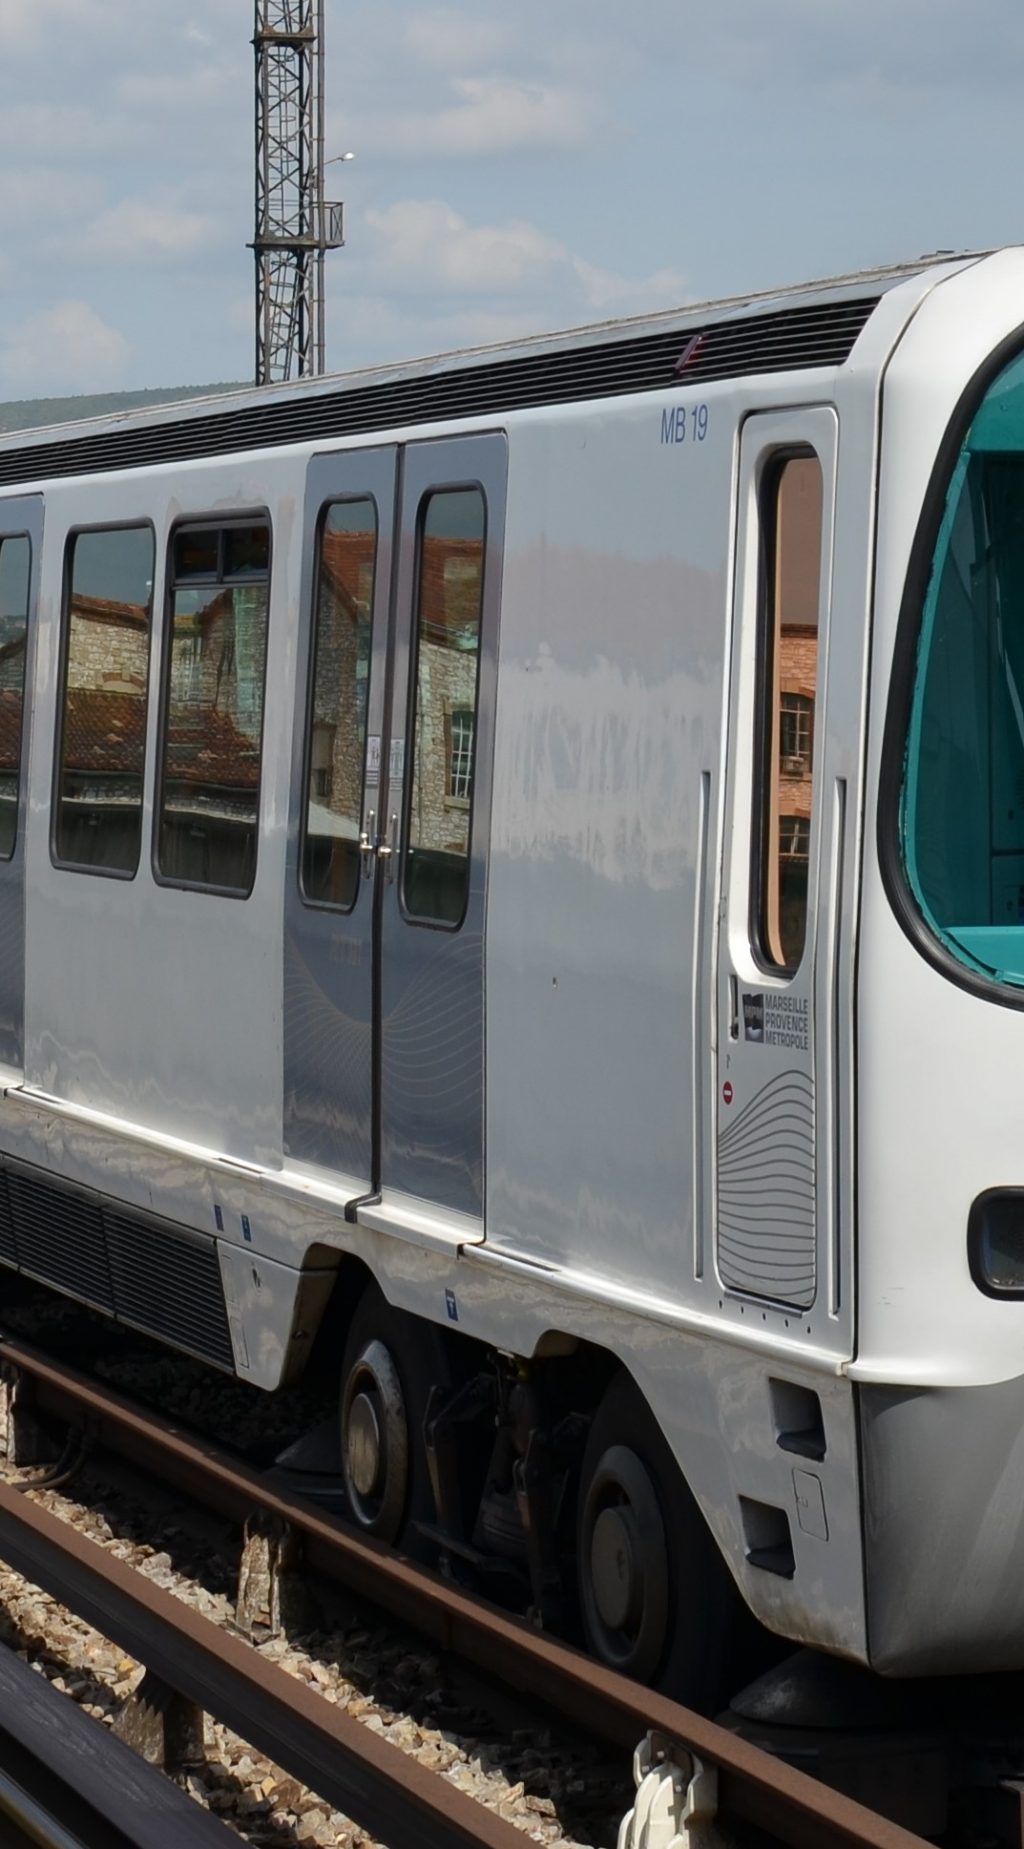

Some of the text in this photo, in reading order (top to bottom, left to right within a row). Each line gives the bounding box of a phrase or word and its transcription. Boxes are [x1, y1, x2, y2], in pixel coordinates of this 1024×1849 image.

[661, 404, 708, 444] MB 19
[765, 994, 808, 1015] MARSEILLE
[765, 1012, 808, 1033] PROVENCE
